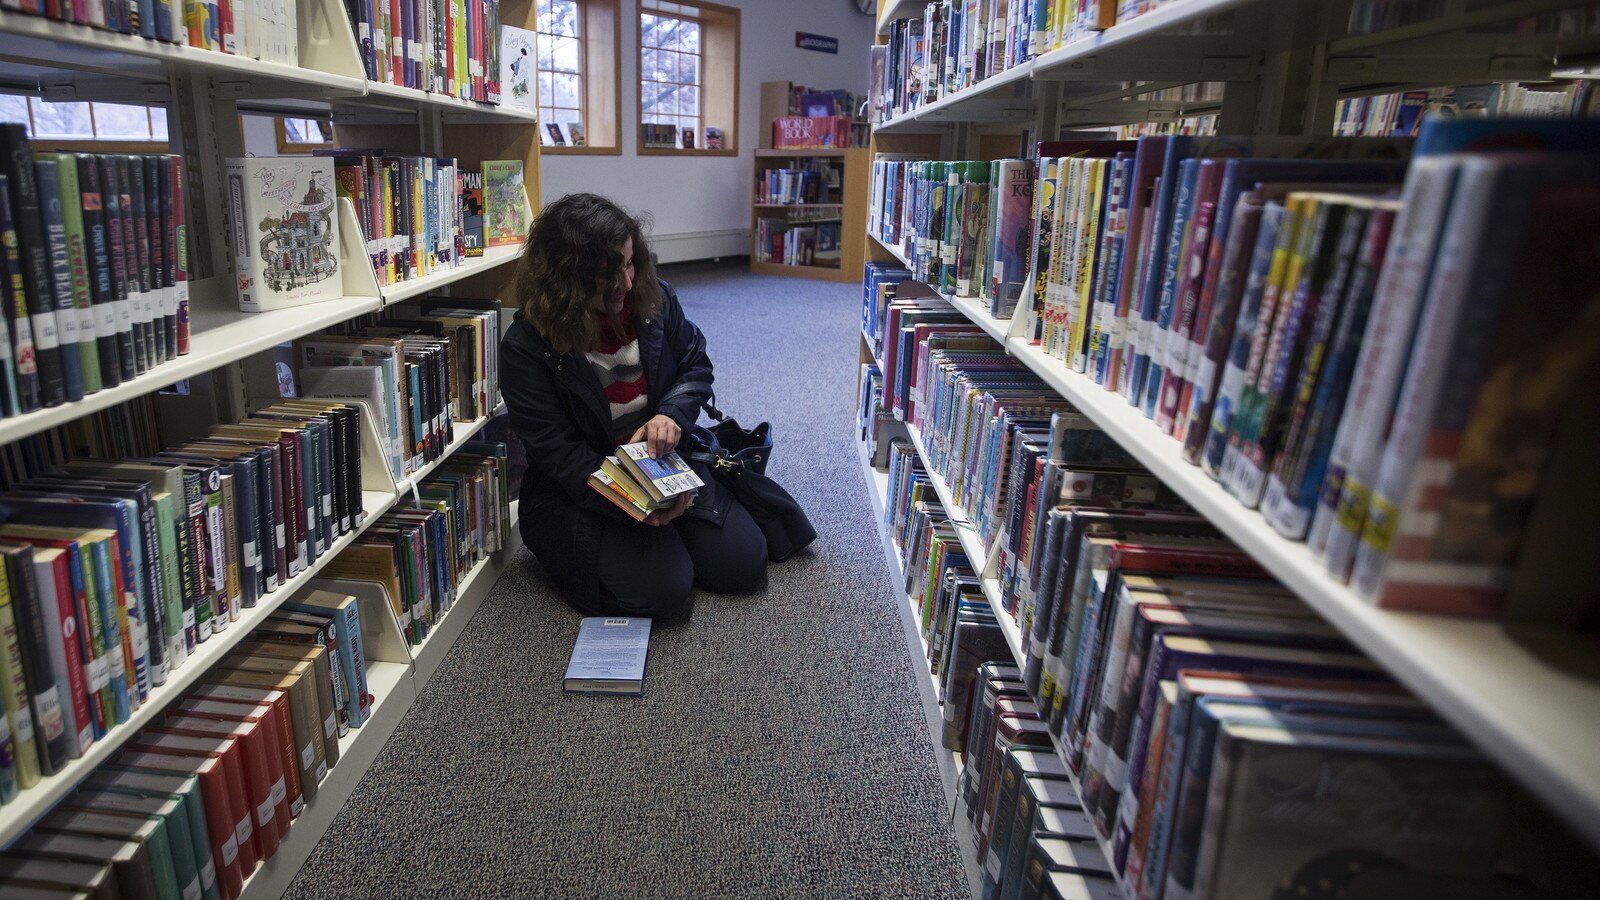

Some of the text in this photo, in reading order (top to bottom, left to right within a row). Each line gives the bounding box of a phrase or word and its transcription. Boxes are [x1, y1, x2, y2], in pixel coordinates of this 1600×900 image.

[805, 38, 836, 49] BIOGRAPHY
[780, 119, 813, 129] WORLD
[785, 129, 812, 139] BOOK
[92, 224, 104, 253] CIRQUE
[1168, 186, 1190, 251] OLIVIA
[178, 228, 187, 268] CANNED
[464, 234, 478, 246] SPY
[33, 248, 50, 288] Black
[48, 224, 73, 307] BLACK BEAU
[95, 256, 106, 265] DU
[96, 269, 109, 292] FREAK
[1097, 248, 1118, 359] ARTSY CLUB
[144, 523, 160, 623] STORM RUNNERS
[179, 521, 192, 598] TENTACLES
[68, 639, 82, 688] counting
